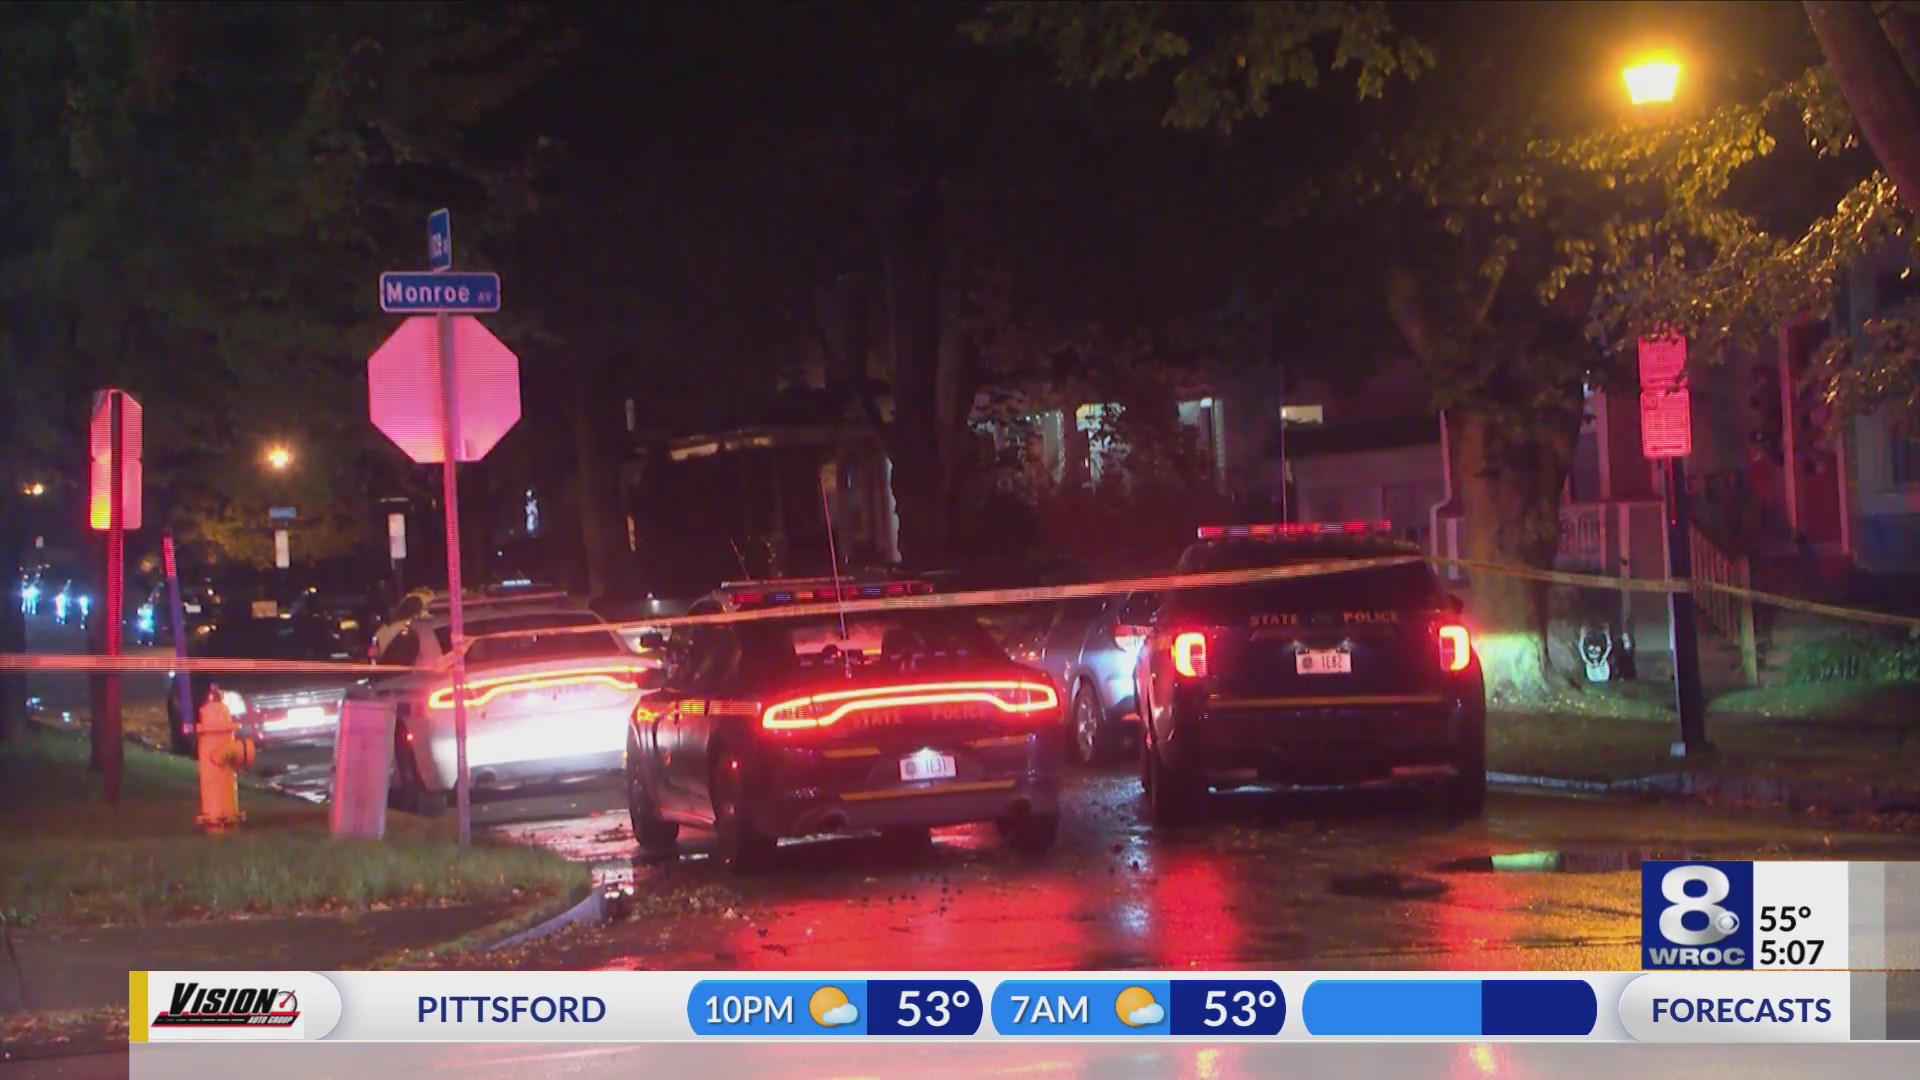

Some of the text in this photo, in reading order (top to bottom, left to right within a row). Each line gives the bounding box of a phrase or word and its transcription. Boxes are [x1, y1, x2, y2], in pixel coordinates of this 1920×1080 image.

[386, 282, 470, 303] Monroe
[1250, 610, 1399, 626] STATE POLICE
